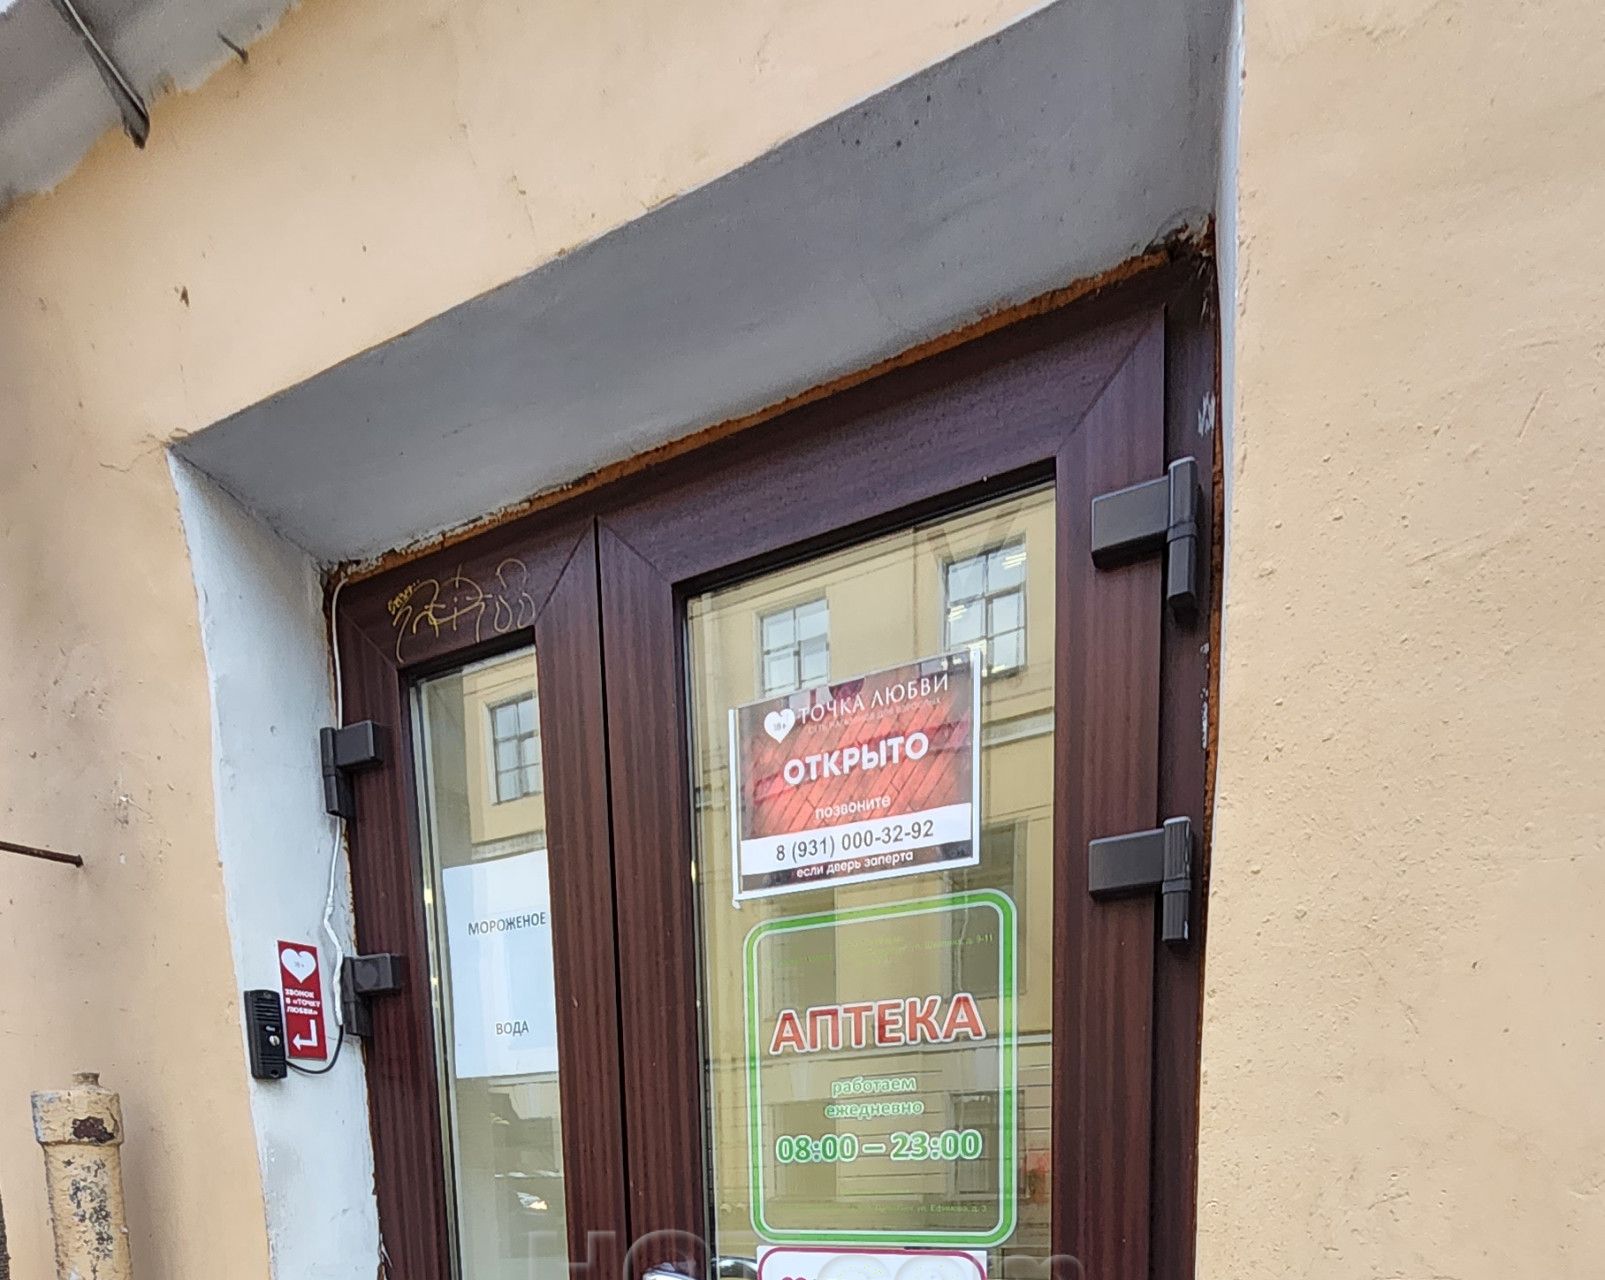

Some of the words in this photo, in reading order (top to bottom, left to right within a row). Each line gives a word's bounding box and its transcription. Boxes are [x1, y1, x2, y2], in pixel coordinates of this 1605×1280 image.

[798, 696, 865, 724] ТОЧКА
[871, 674, 949, 709] ЛЮБВИ
[783, 732, 929, 785] ОТКРЫТО
[815, 795, 891, 820] позвоните
[776, 844, 786, 861] 8
[792, 835, 835, 863] (931)
[841, 819, 934, 850] 000-32-92
[796, 866, 824, 878] если
[827, 860, 862, 876] дверь
[864, 850, 914, 868] заперта
[468, 912, 546, 935] МОРОЖЕНОЕ
[285, 988, 314, 998] ЗВОНОК
[496, 1021, 529, 1036] ВОДА
[769, 992, 986, 1055] АПТЕКА
[832, 1076, 916, 1098] работаем
[825, 1101, 924, 1120] ежедневно
[775, 1134, 858, 1163] 08:00
[890, 1129, 983, 1161] 23:00
